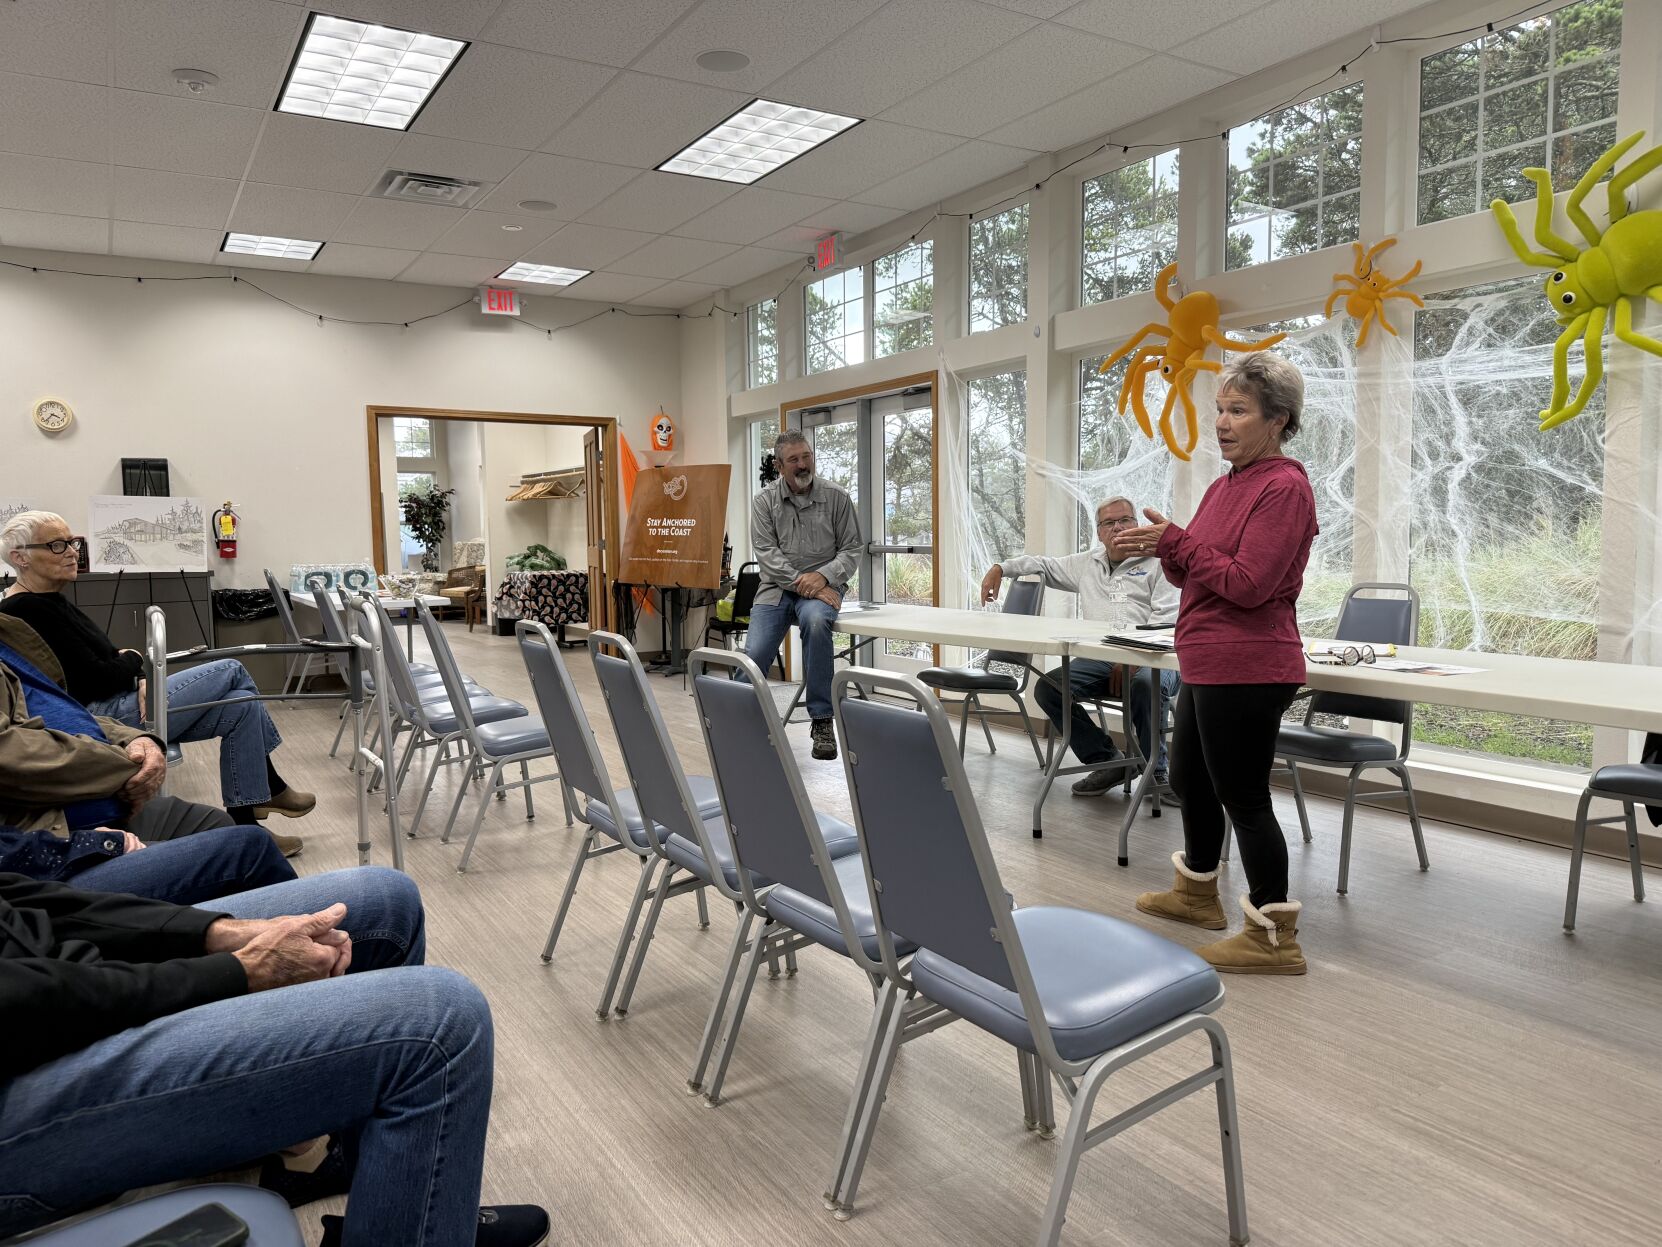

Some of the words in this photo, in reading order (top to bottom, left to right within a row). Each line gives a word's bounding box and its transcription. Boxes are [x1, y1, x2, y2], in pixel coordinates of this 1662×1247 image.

[818, 236, 835, 270] EXIT
[487, 288, 513, 312] EXIT
[646, 517, 661, 526] STAY
[661, 517, 696, 526] ANCHORED
[670, 527, 691, 535] COAST
